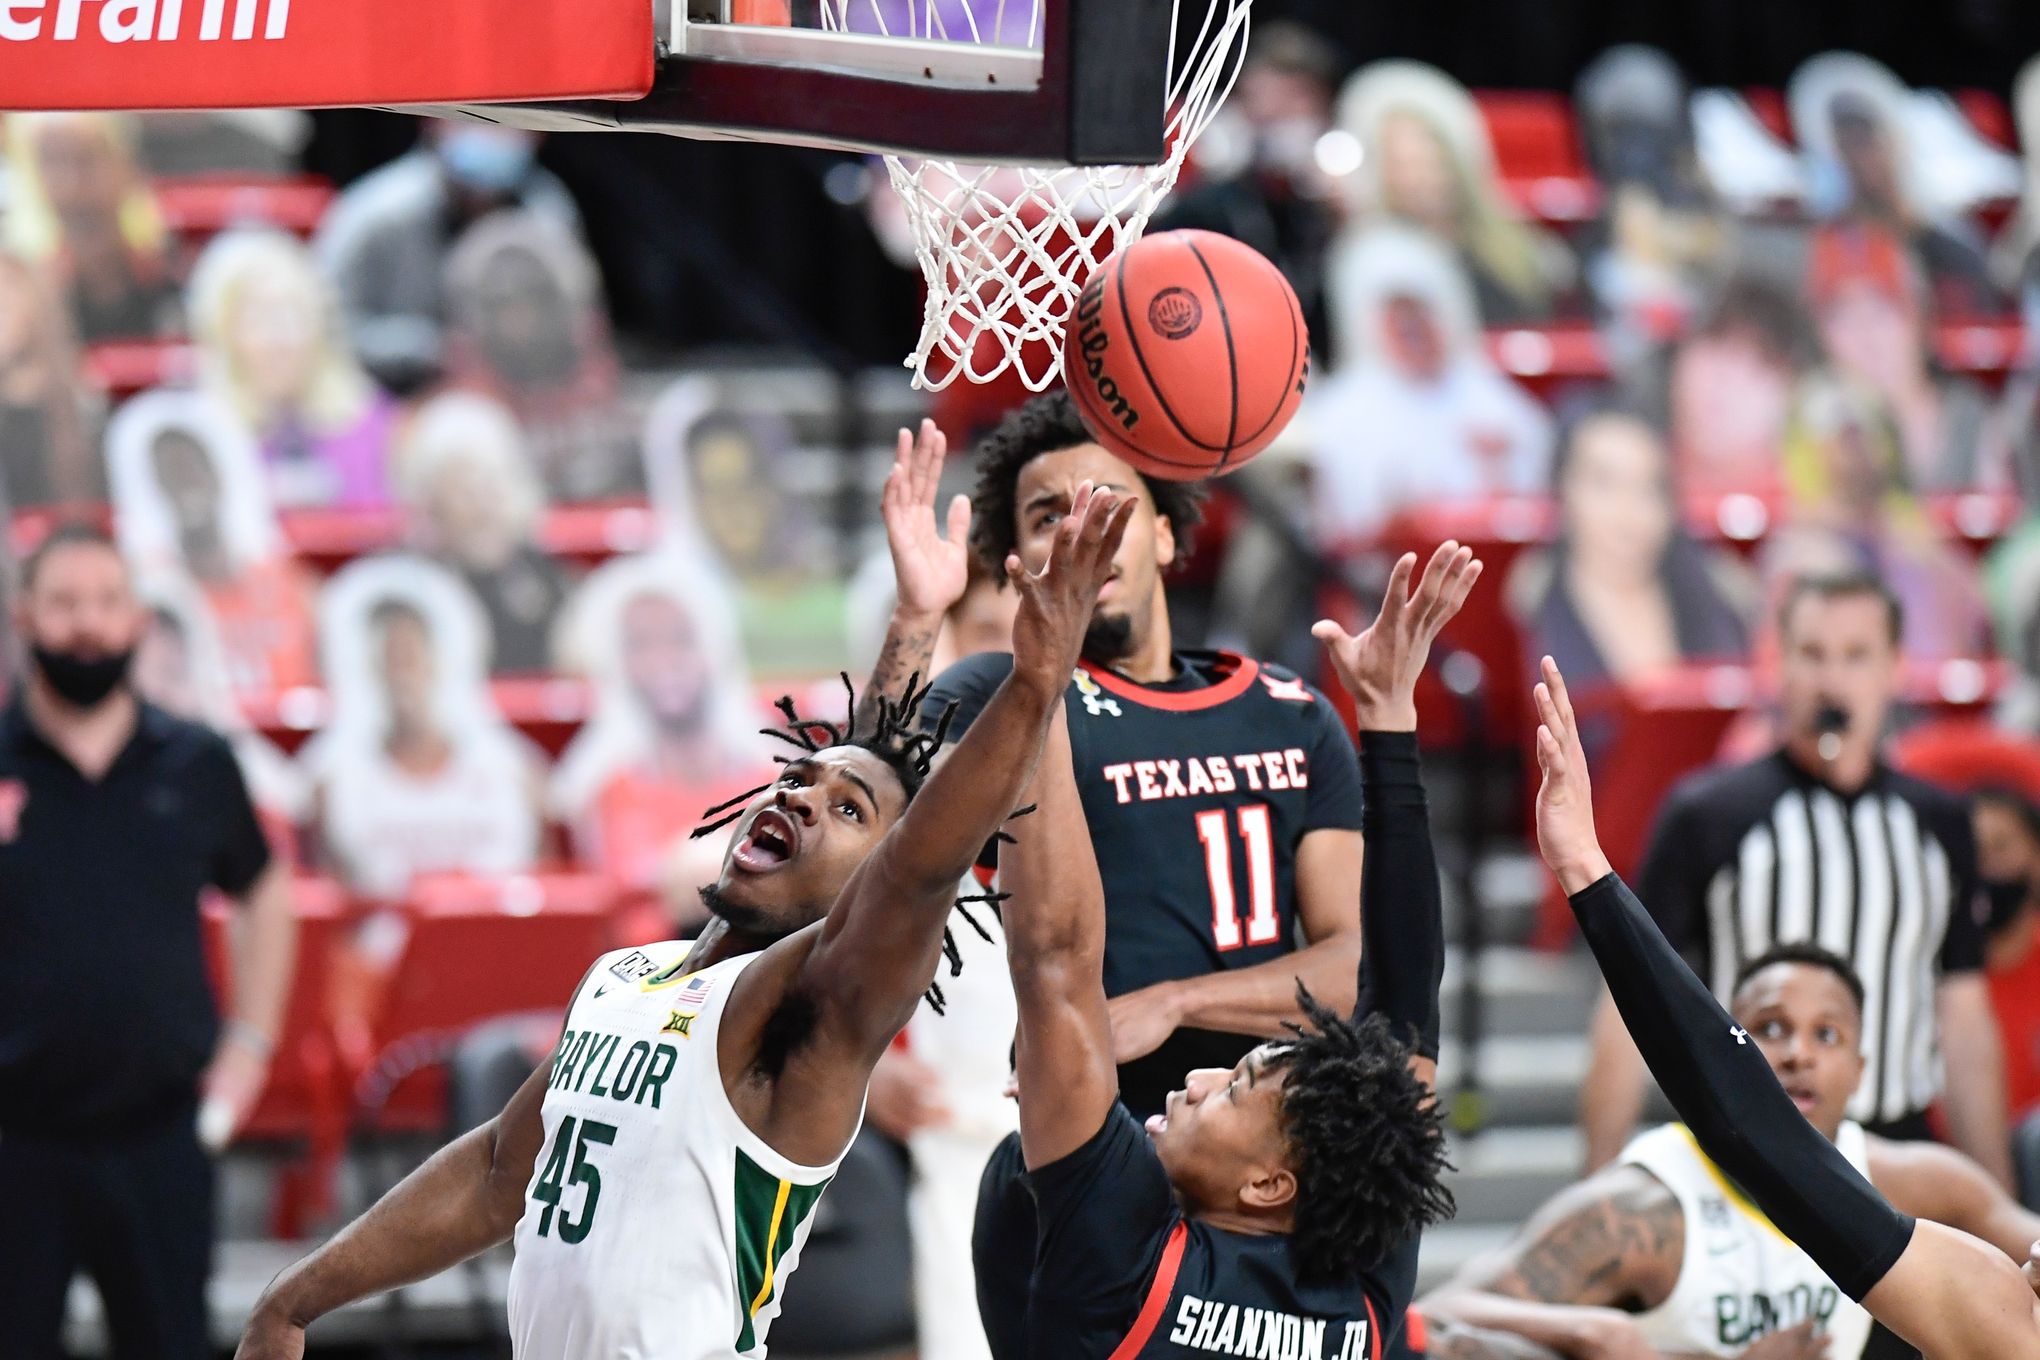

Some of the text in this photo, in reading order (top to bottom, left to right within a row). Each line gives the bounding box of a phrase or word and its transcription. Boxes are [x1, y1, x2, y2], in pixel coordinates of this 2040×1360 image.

[1078, 273, 1139, 430] Wilson
[1104, 757, 1236, 804] TEXAS
[1195, 804, 1280, 951] 11
[548, 1030, 678, 1109] BAYLOR
[531, 1115, 618, 1244] 45
[1170, 1294, 1326, 1360] SHANNON
